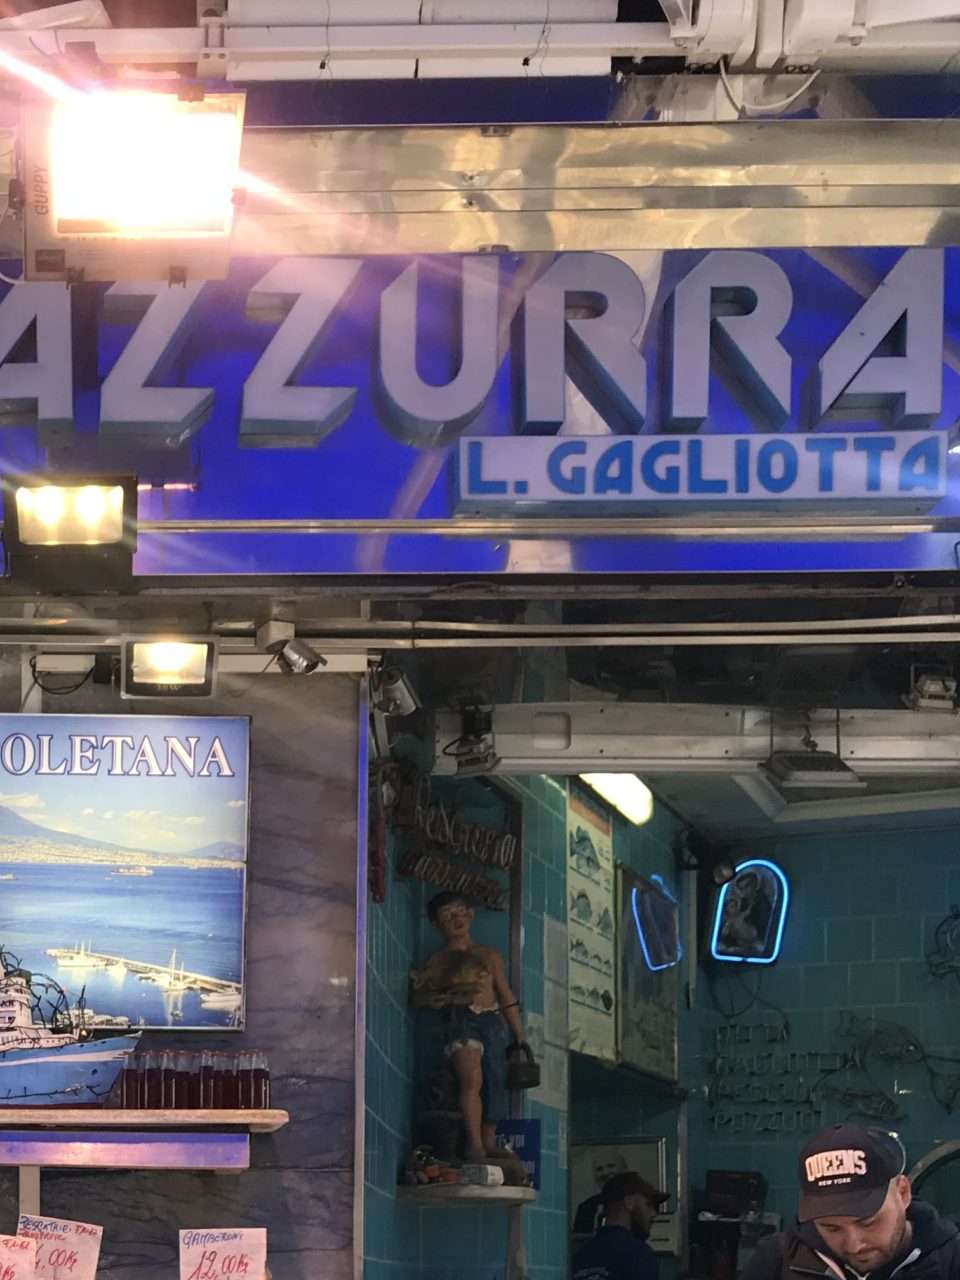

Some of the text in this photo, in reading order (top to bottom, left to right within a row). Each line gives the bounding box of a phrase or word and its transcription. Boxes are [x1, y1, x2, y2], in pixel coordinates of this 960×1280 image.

[468, 436, 941, 495] L. GAGLIOTTA
[805, 1149, 867, 1182] QUEENS
[818, 1178, 832, 1186] NEW
